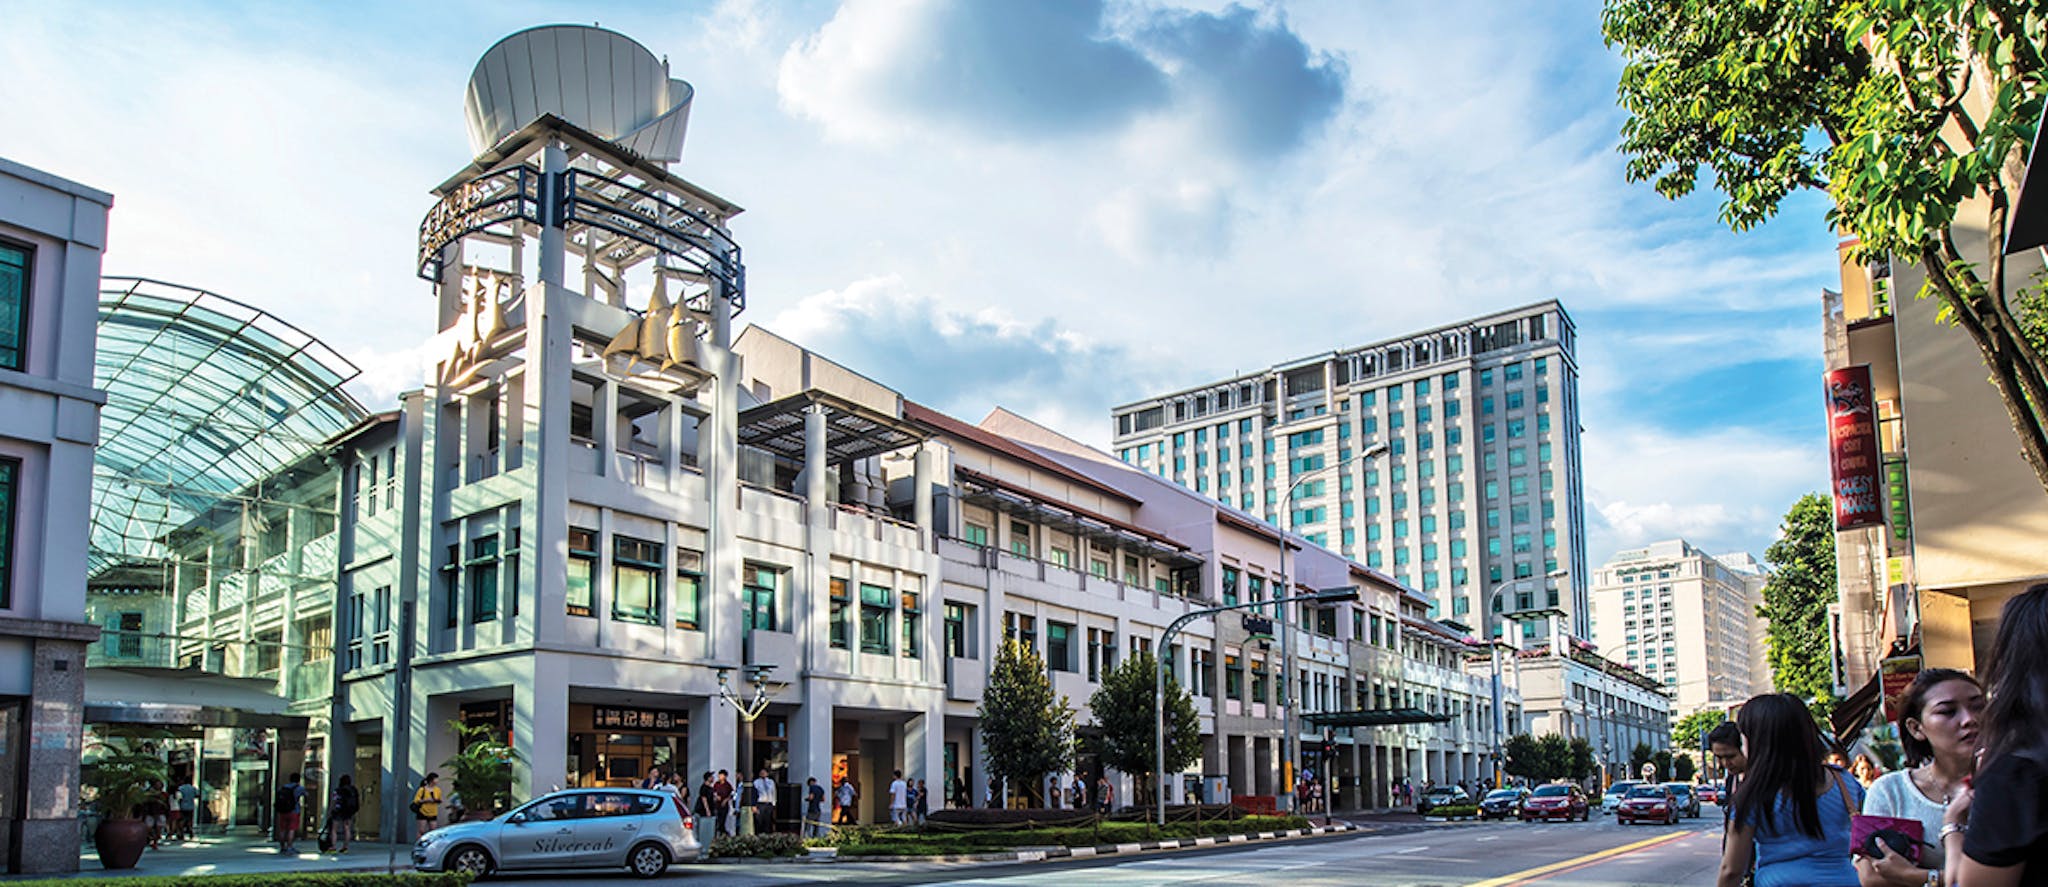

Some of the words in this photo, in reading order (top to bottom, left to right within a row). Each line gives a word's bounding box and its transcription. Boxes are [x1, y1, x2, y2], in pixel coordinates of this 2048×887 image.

[1839, 475, 1874, 497] GUEST
[1839, 494, 1877, 516] HOUSE
[532, 835, 614, 853] Silvercab
